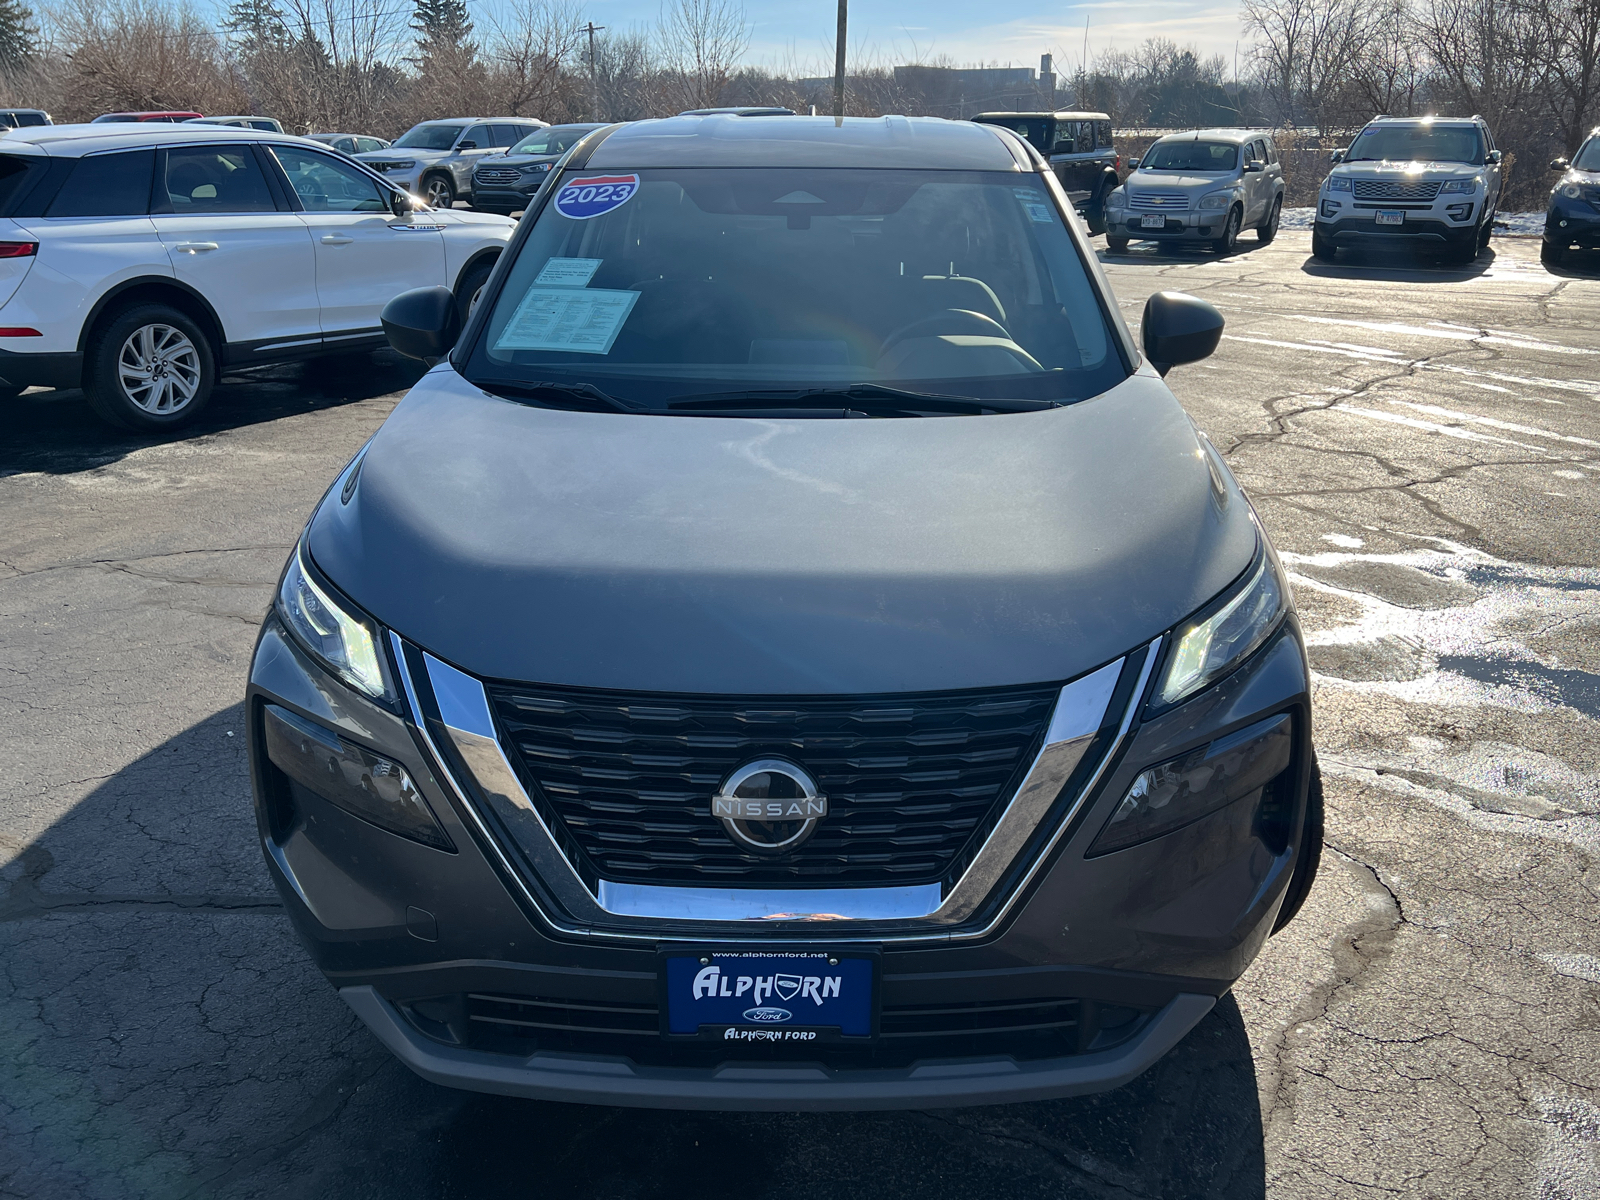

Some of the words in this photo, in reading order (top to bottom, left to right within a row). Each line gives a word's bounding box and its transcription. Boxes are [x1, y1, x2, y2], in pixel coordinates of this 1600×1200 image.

[559, 185, 631, 205] 2023
[716, 800, 824, 816] NISSAN
[753, 1010, 783, 1020] Ford
[785, 1031, 816, 1040] FORD
